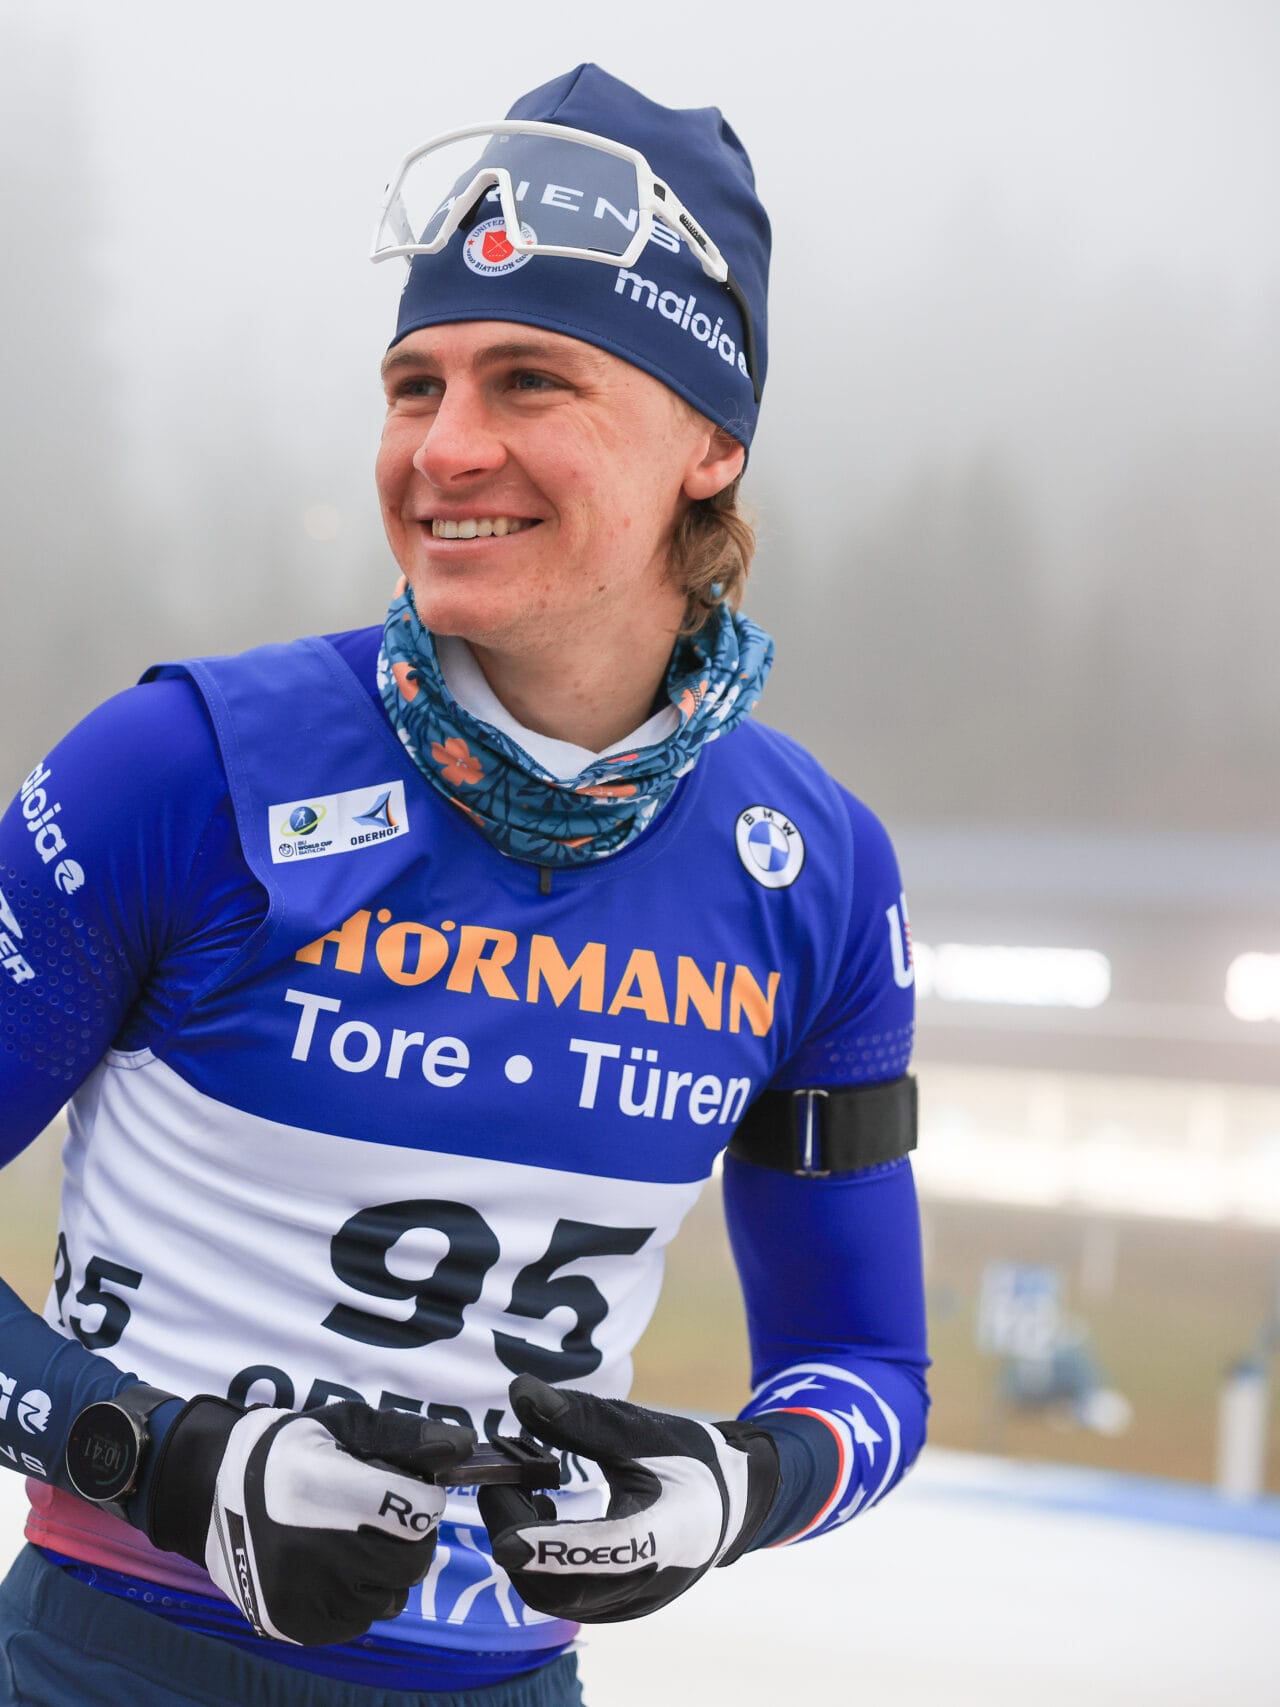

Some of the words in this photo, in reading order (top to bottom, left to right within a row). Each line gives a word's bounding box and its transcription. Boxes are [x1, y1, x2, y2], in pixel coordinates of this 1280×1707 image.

[474, 261, 516, 273] BIATHLON
[614, 267, 737, 363] maloja
[350, 825, 400, 846] OBERHOF
[295, 908, 782, 1037] HÖRMANN
[283, 988, 470, 1089] Tore
[568, 1038, 751, 1125] Türen
[320, 1199, 657, 1384] 95
